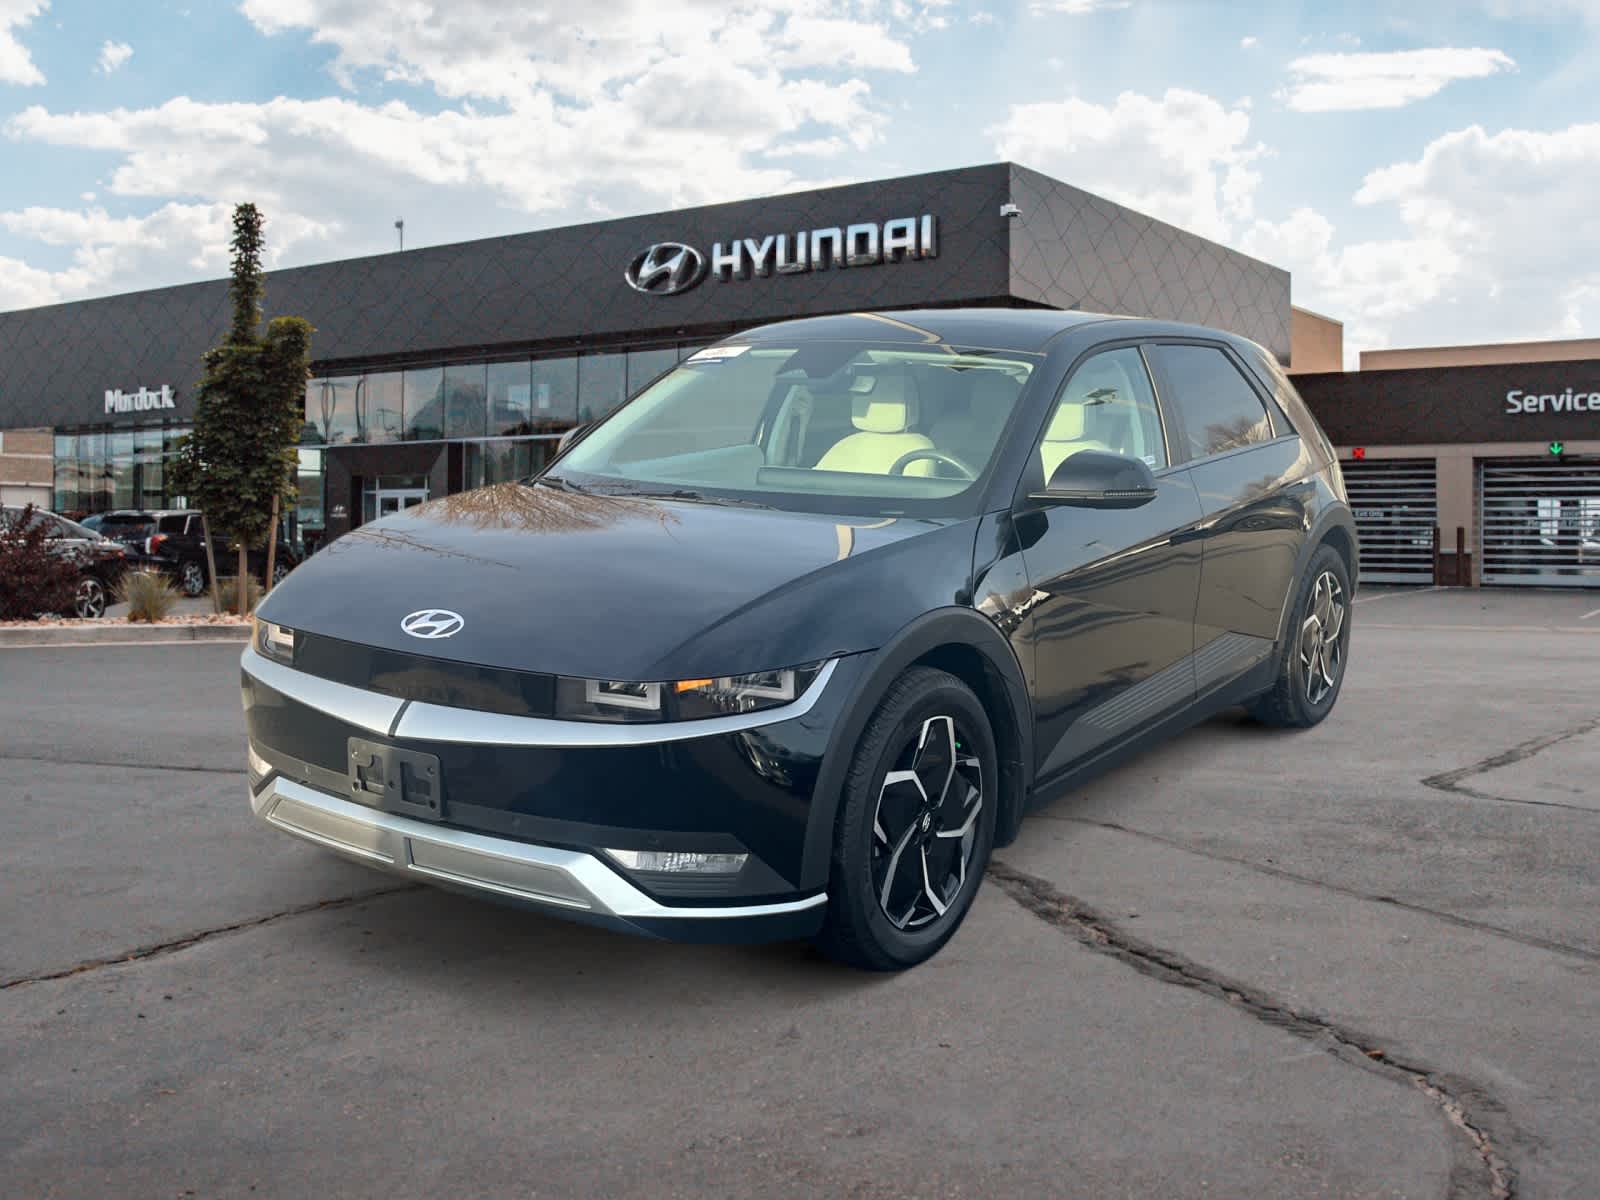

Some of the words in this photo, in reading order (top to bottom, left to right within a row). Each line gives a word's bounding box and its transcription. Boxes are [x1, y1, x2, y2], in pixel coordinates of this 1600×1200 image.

[711, 213, 937, 283] HYUNDAI
[104, 384, 176, 414] Murdock
[1505, 387, 1600, 414] Service
